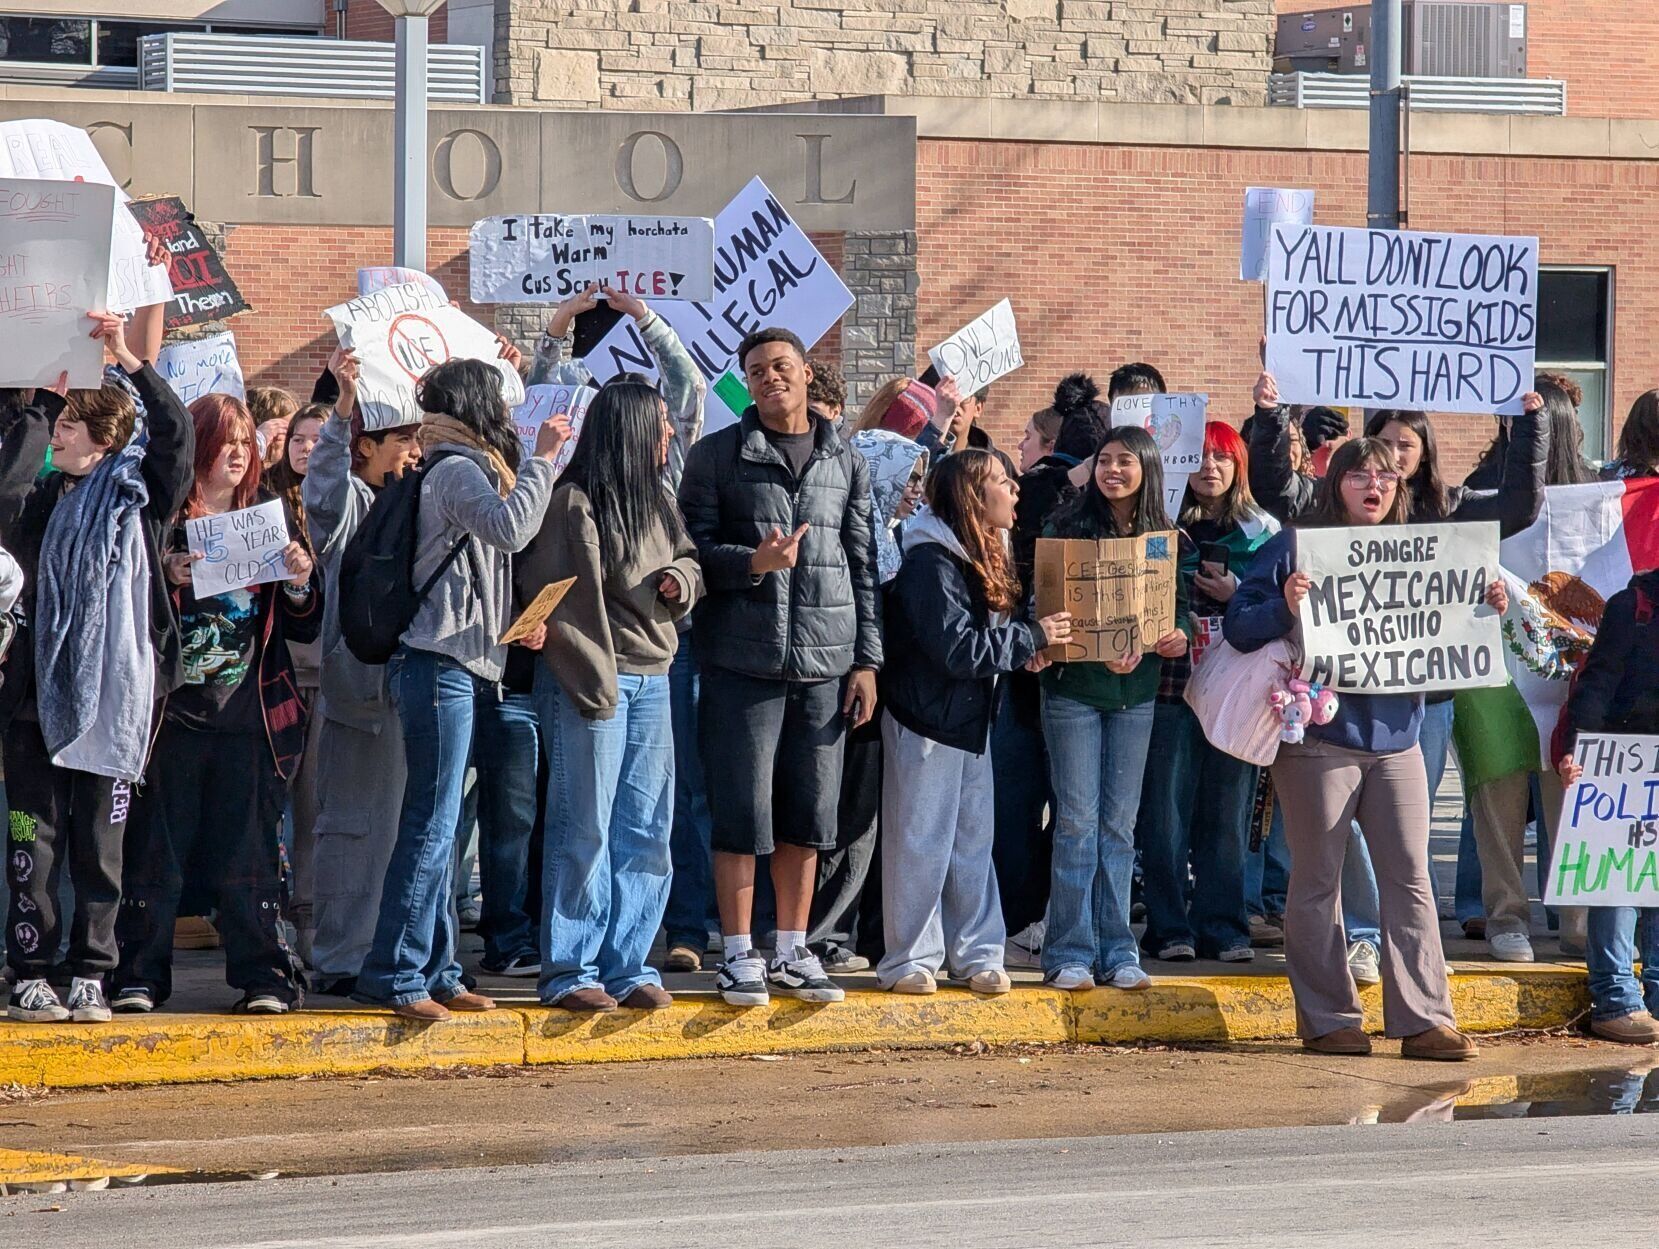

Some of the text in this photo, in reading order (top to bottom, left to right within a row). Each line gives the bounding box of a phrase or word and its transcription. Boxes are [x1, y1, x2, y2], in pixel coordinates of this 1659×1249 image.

[503, 219, 517, 241] I
[591, 225, 613, 245] my
[628, 220, 688, 236] horchata
[552, 243, 608, 264] Warm
[1435, 237, 1528, 295] LOOK
[557, 268, 608, 295] Scrw
[1272, 290, 1535, 344] FOR MISSIG KIDS
[1302, 344, 1522, 405] THIS HARD
[1117, 397, 1197, 410] LOVE THY
[1164, 454, 1200, 464] HBORS
[195, 510, 265, 541] HE WAS
[204, 524, 287, 562] 5 YEARS
[1348, 536, 1438, 567] SANGRE
[1308, 566, 1486, 627] MEXICANA
[1309, 645, 1491, 688] MEXICANO
[1571, 780, 1659, 828] POLI
[1556, 841, 1659, 896] HUMA
